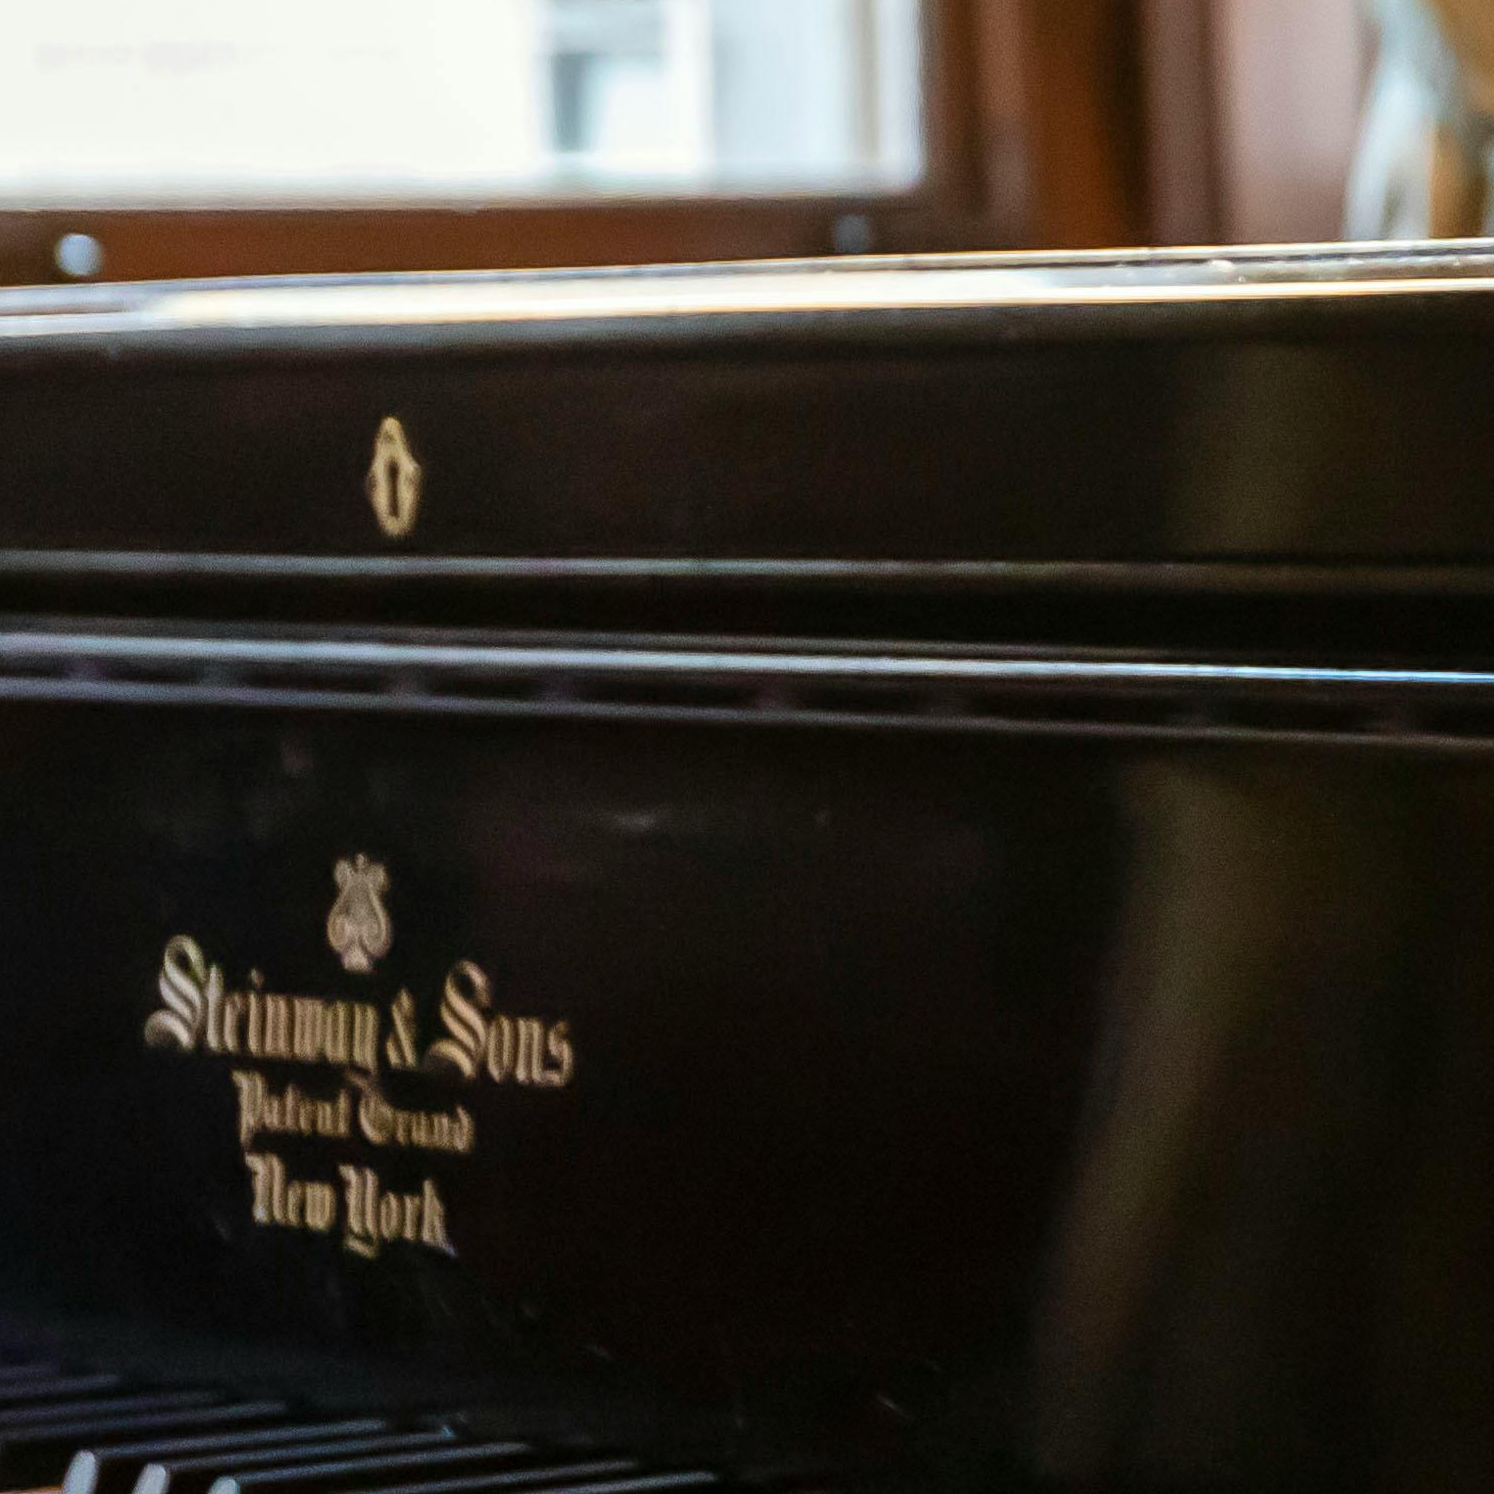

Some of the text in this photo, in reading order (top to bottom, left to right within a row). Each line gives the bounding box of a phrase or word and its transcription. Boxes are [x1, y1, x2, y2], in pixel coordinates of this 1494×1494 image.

[144, 934, 573, 1086] Steinway & Sons
[232, 1068, 474, 1153] Patent Grand
[245, 1153, 457, 1257] New York
